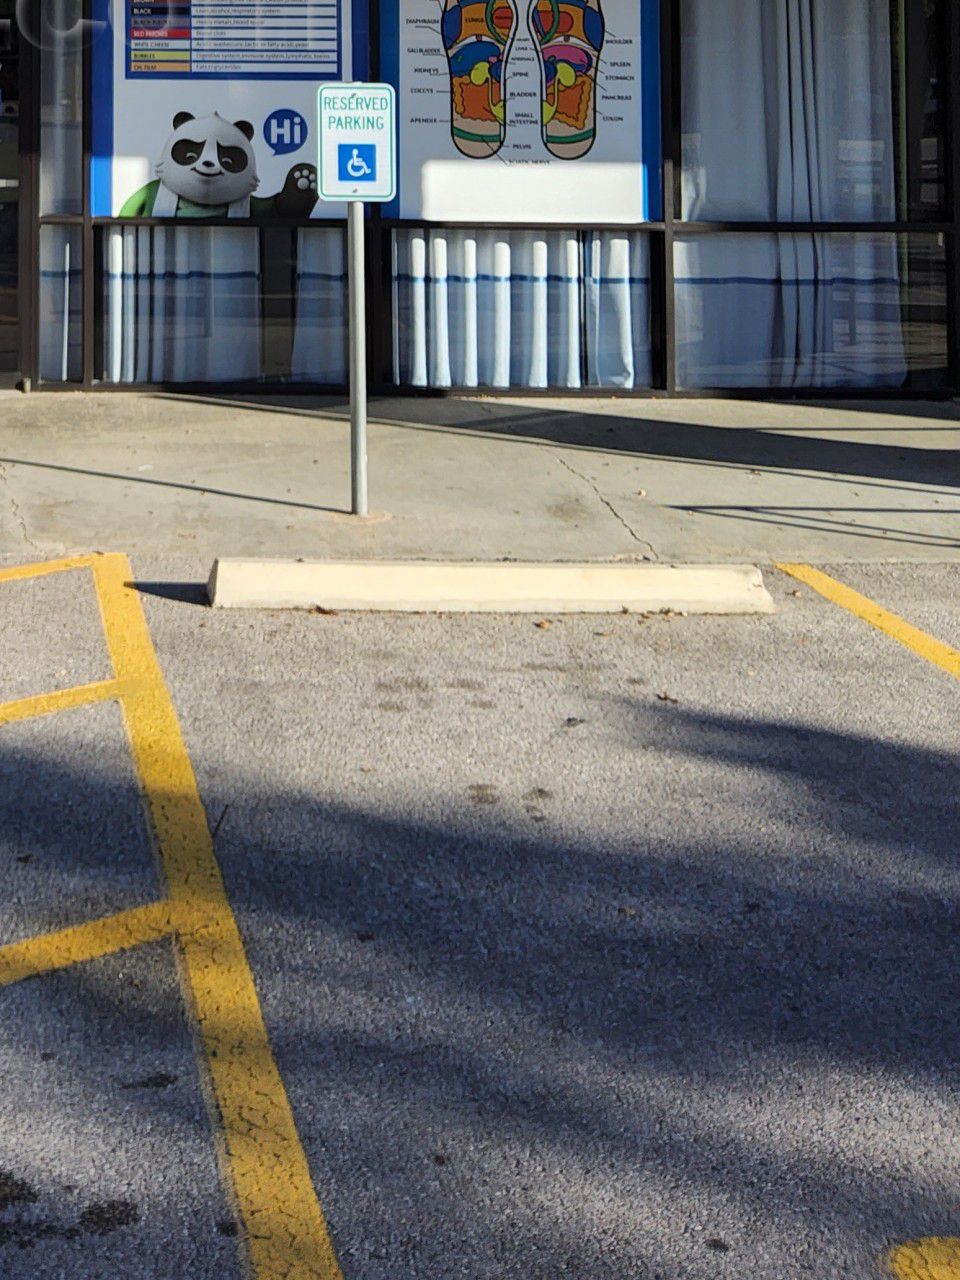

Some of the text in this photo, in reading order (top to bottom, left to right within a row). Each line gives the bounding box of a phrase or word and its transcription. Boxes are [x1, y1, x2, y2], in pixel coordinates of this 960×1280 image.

[323, 95, 388, 111] RESERVED
[270, 116, 301, 145] Hi
[328, 116, 384, 131] PARKING
